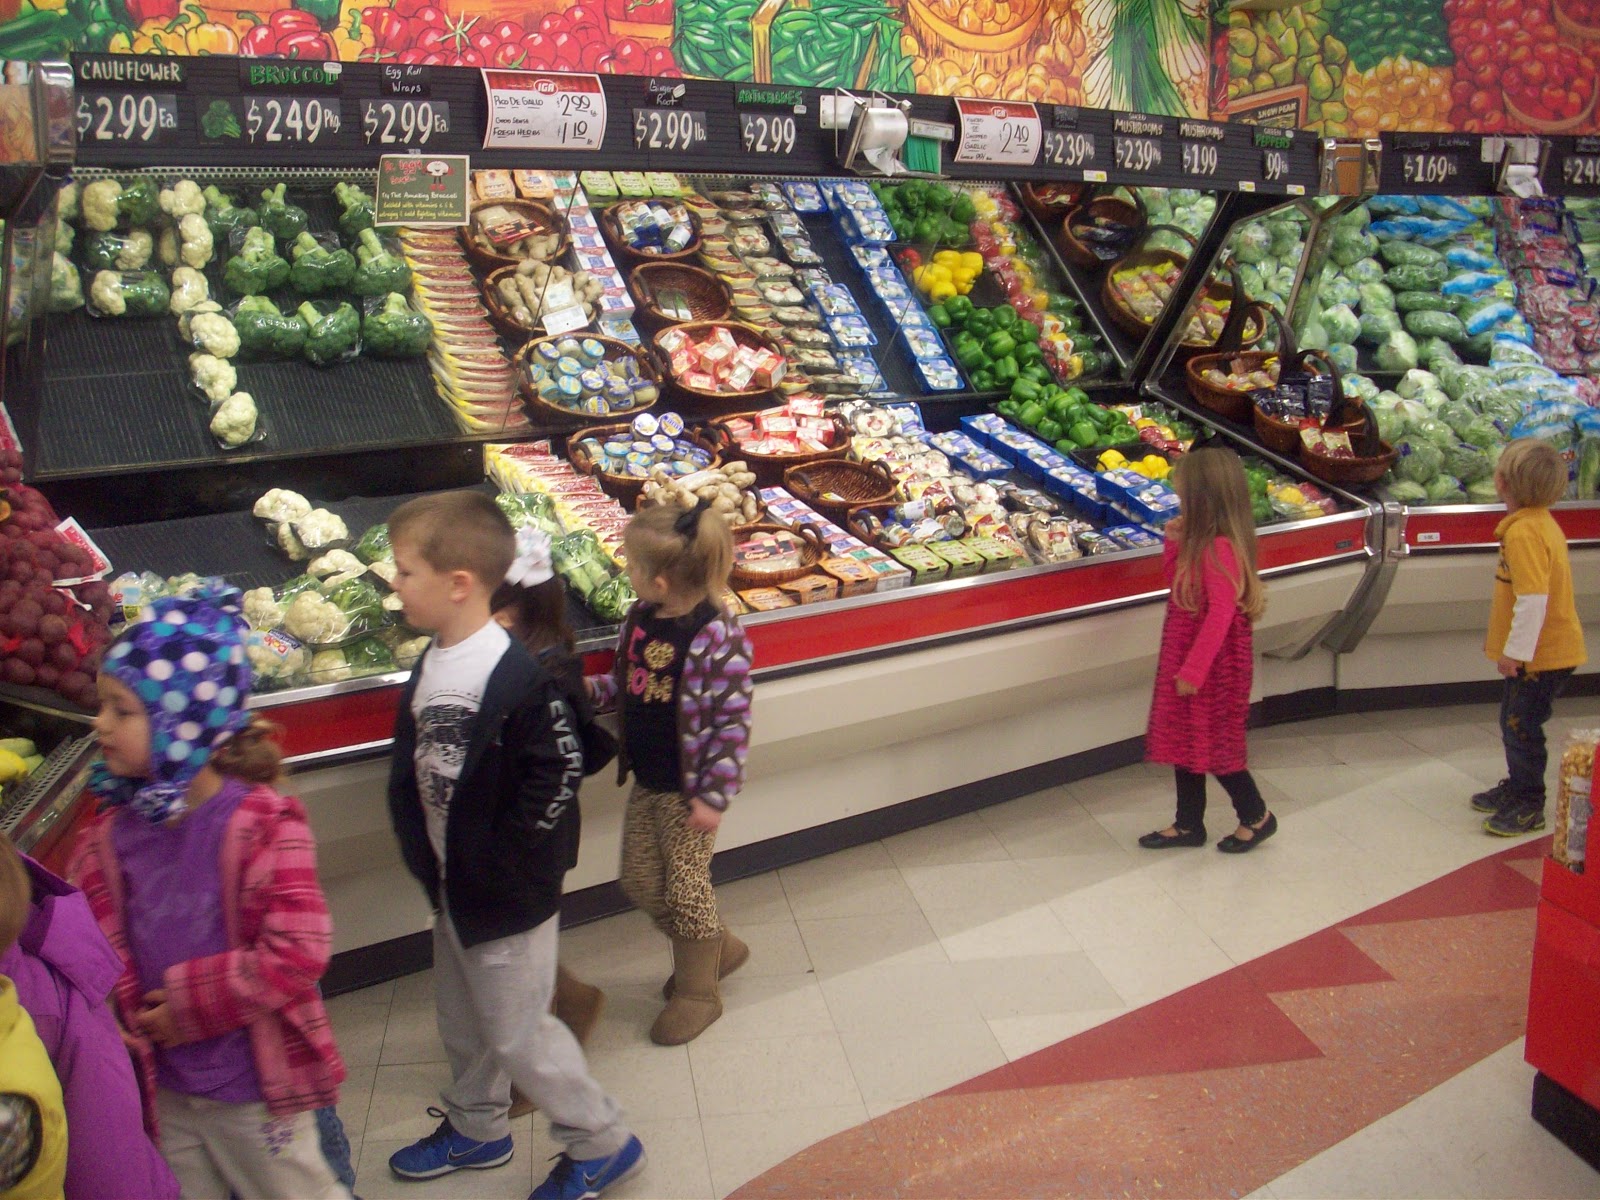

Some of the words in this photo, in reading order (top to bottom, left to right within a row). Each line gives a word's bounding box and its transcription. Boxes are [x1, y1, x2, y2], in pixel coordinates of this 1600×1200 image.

[81, 60, 182, 82] CAULIFLOWER
[385, 65, 402, 79] Egg
[406, 65, 422, 75] Roll
[392, 81, 421, 93] Wraps
[538, 82, 554, 92] IGA
[656, 95, 678, 106] Root
[76, 94, 157, 141] $2.99
[247, 98, 322, 144] $2.49
[365, 102, 433, 145] $2.99
[493, 127, 516, 136] FRESH
[636, 111, 693, 150] $2.99
[744, 116, 796, 154] $2.99
[1114, 119, 1163, 136] MUSHROOMS
[1180, 122, 1224, 140] MUSHROOMS
[403, 192, 430, 201] Amazing
[264, 635, 288, 654] Dole
[537, 700, 584, 831] EVERLAST
